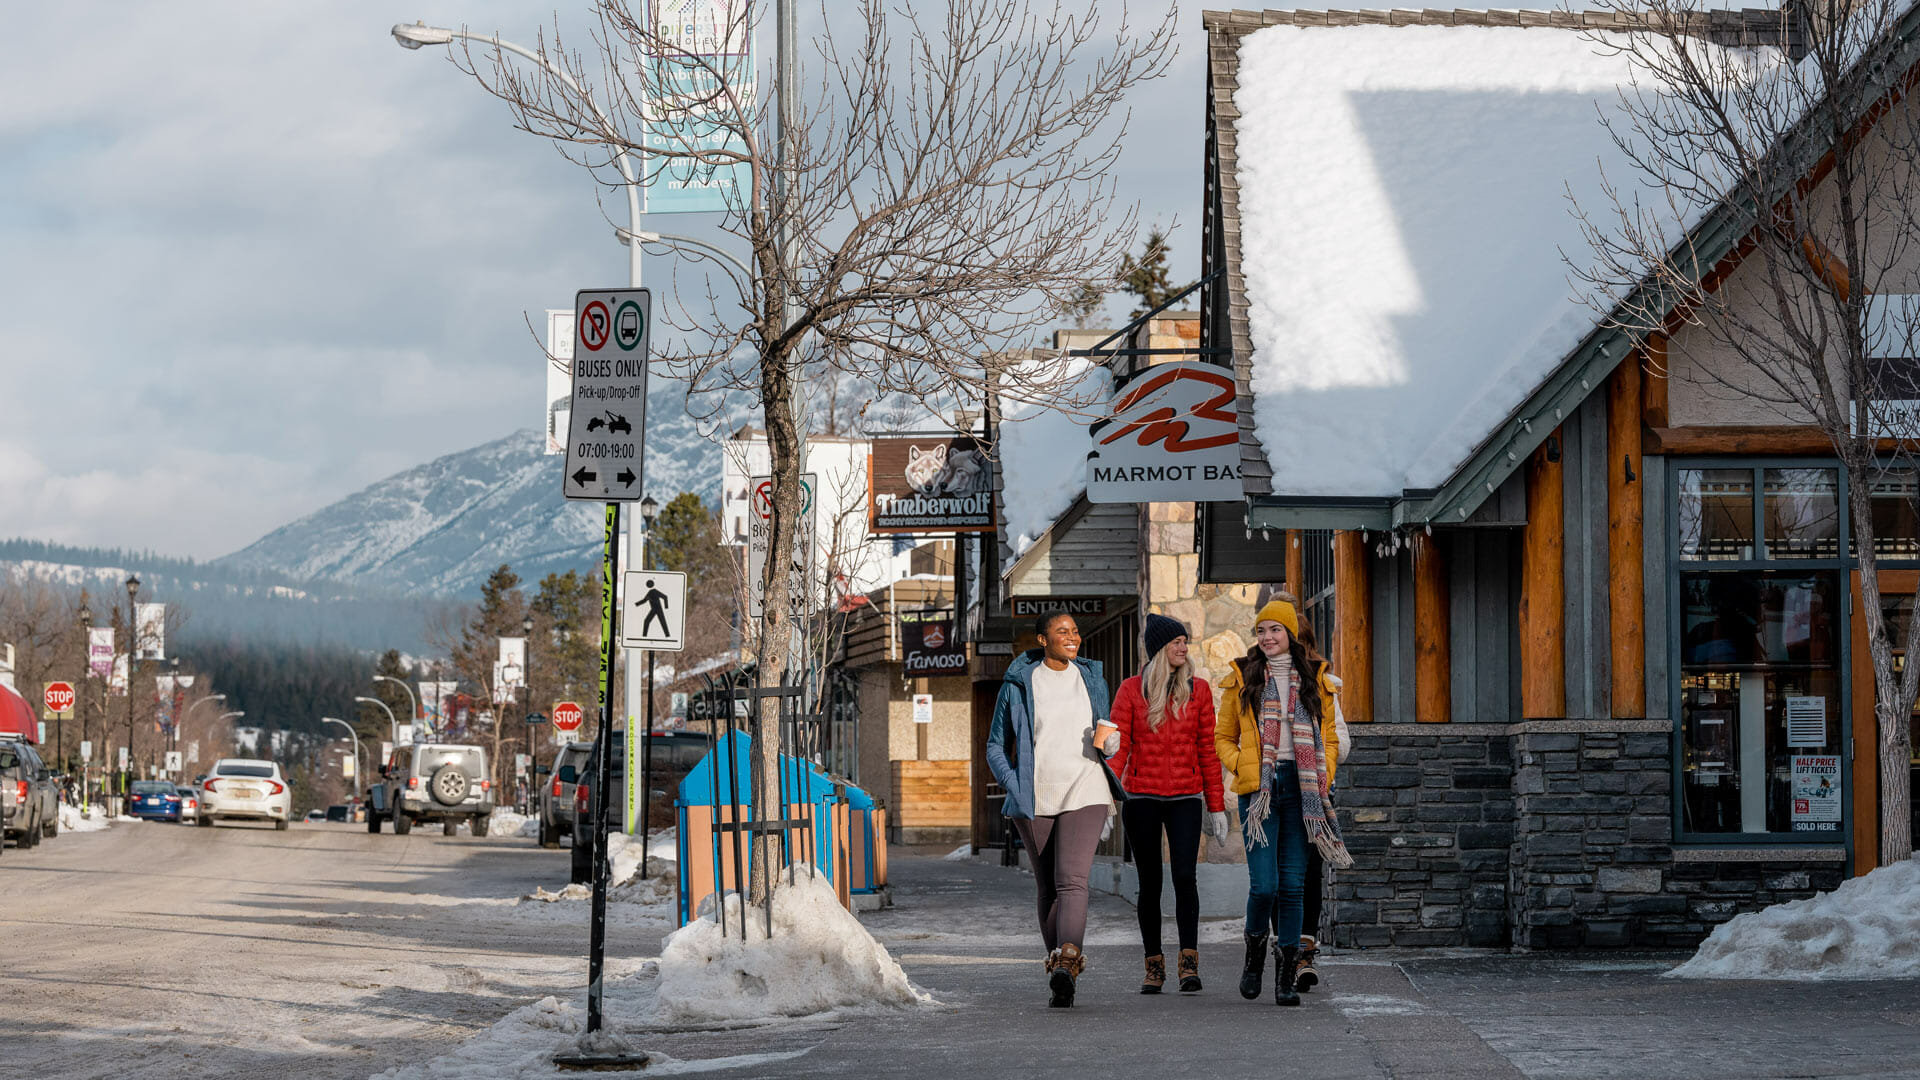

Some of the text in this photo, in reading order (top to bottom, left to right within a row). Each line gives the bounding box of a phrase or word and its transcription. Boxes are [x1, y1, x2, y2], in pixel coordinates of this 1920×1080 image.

[578, 359, 643, 378] BUSES ONLY
[578, 384, 641, 402] Pick-up/Drop-Off
[578, 443, 635, 458] 07:00-19:00
[1094, 465, 1197, 482] MARMOT
[875, 492, 991, 516] Timberwolf
[1016, 600, 1102, 615] ENTRANCE
[47, 690, 73, 703] STOP
[555, 710, 581, 723] STOP
[1796, 757, 1836, 766] HALF PRICE
[1796, 766, 1837, 774] LIFT TICKETS
[1796, 822, 1837, 831] SOLD HERE
